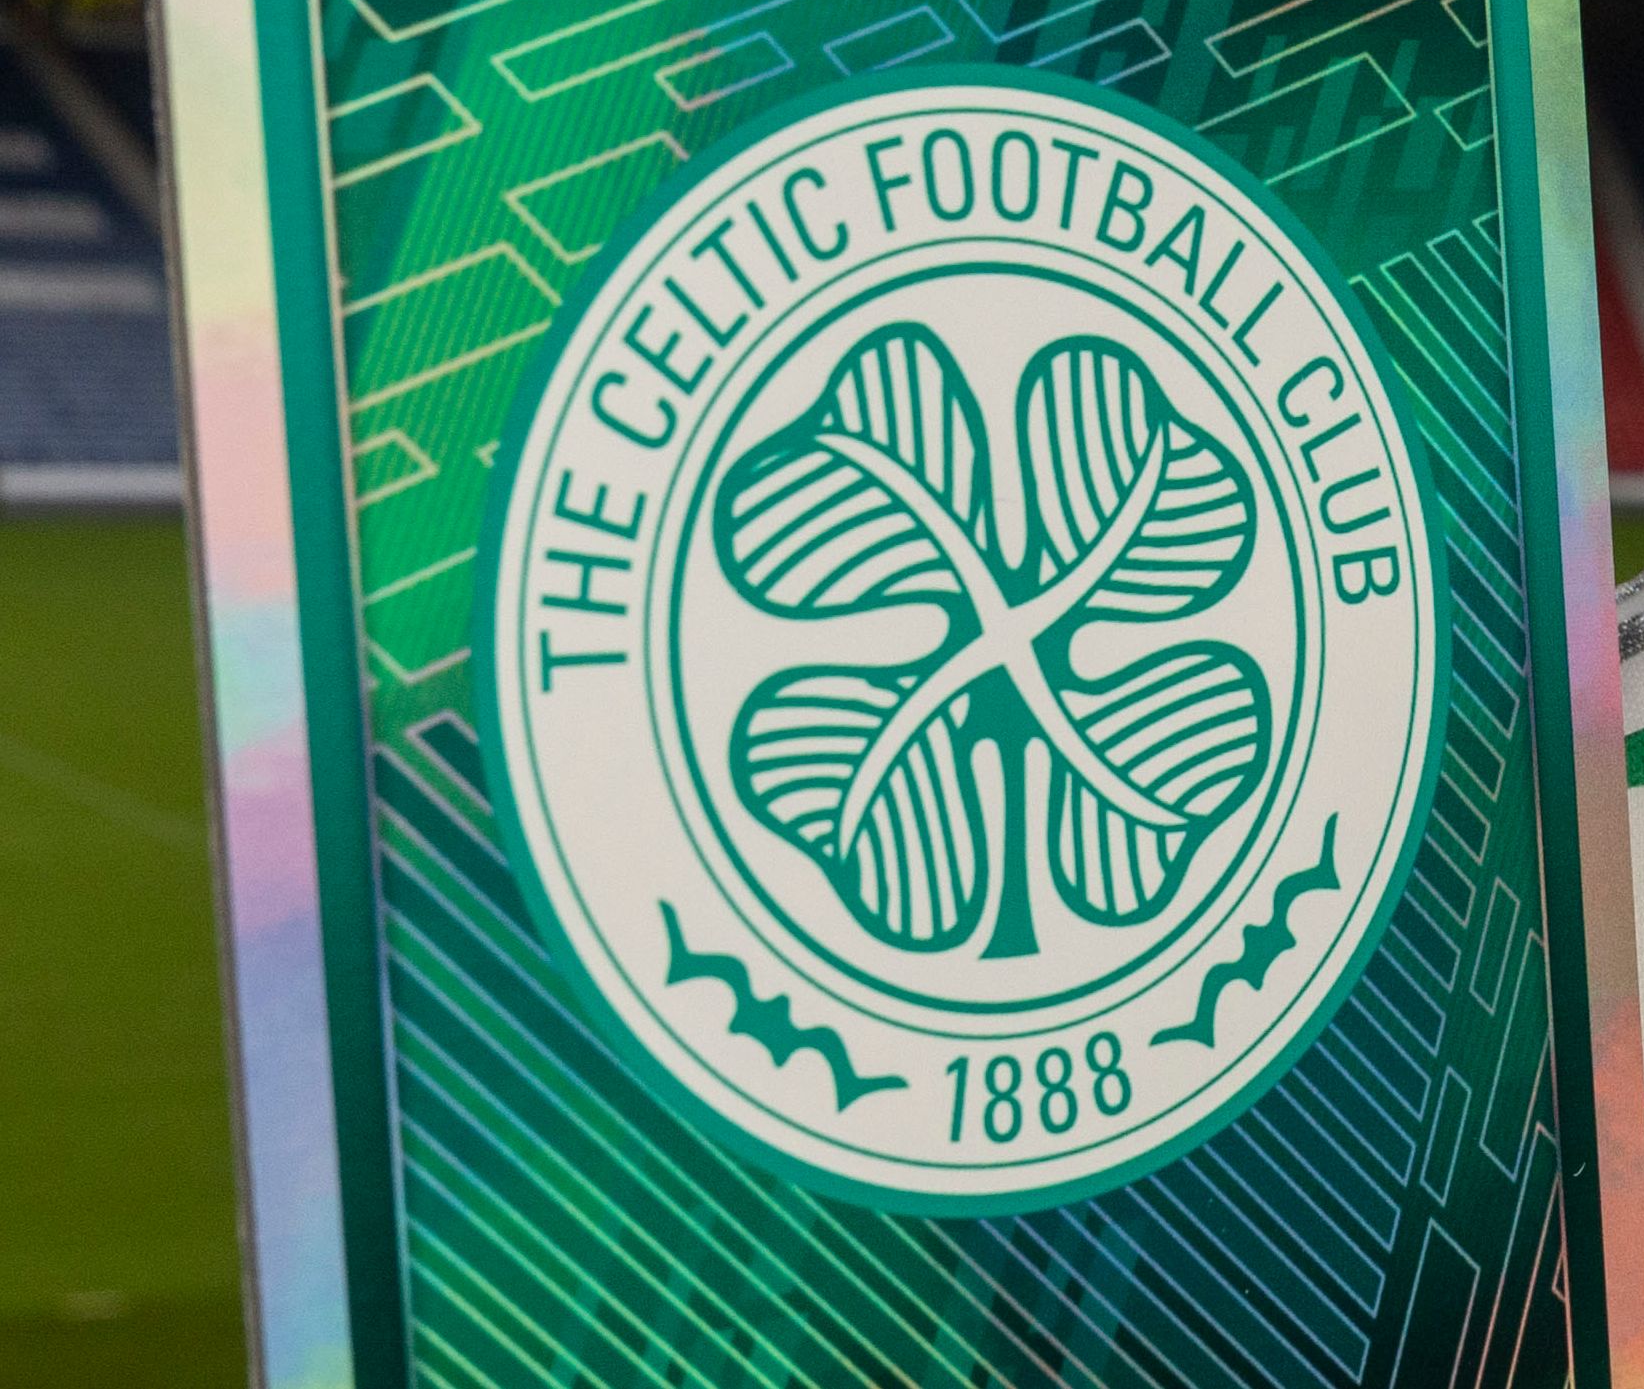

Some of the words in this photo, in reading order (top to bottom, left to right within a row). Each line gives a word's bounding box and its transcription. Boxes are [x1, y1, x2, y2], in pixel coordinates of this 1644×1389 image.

[590, 166, 849, 450] CELTIC
[865, 128, 1284, 368] FOOTBALL
[540, 470, 646, 693] THE
[1276, 355, 1401, 605] CLUB
[946, 1030, 1132, 1144] 1888
